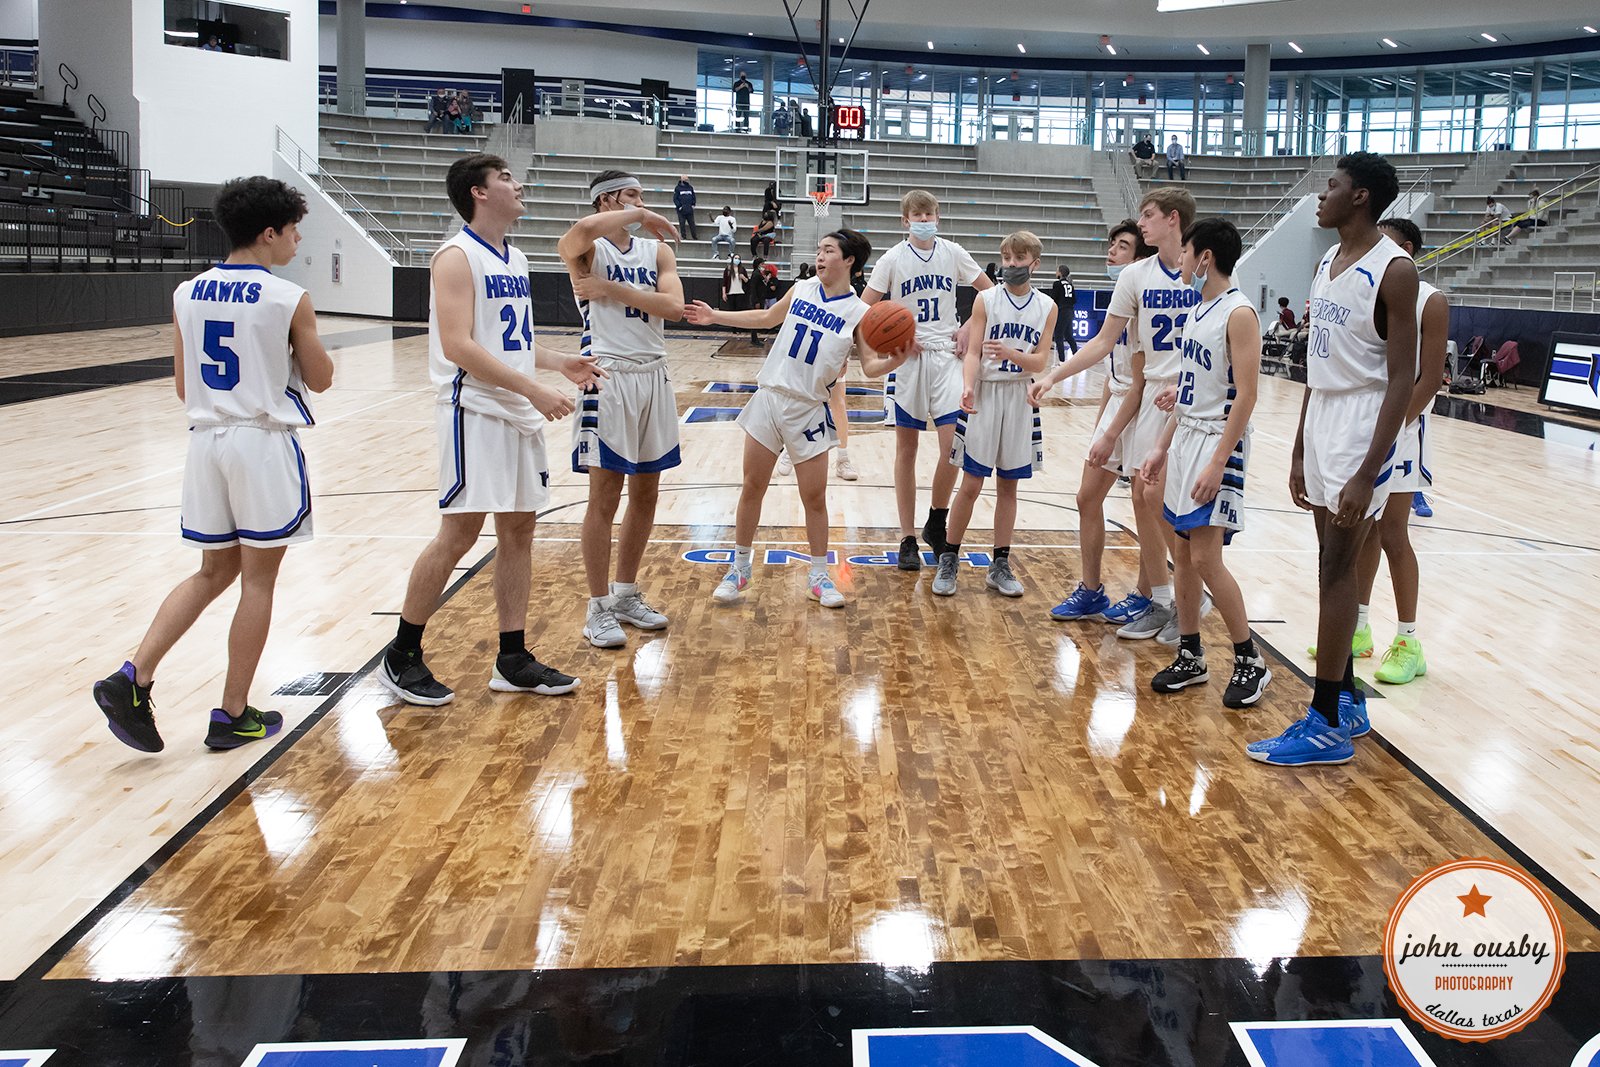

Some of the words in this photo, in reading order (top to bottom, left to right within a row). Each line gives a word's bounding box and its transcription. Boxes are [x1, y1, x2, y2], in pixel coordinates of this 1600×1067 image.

[838, 107, 861, 127] 00
[190, 279, 262, 304] HAWKS
[485, 274, 532, 299] HEBRO
[901, 274, 953, 298] HAWKS
[789, 297, 846, 335] HEBRON
[917, 297, 941, 323] 31
[1310, 297, 1352, 327] BRON
[499, 304, 533, 352] 24
[989, 322, 1042, 347] HAWKS
[200, 319, 241, 391] 5
[787, 322, 824, 366] 11
